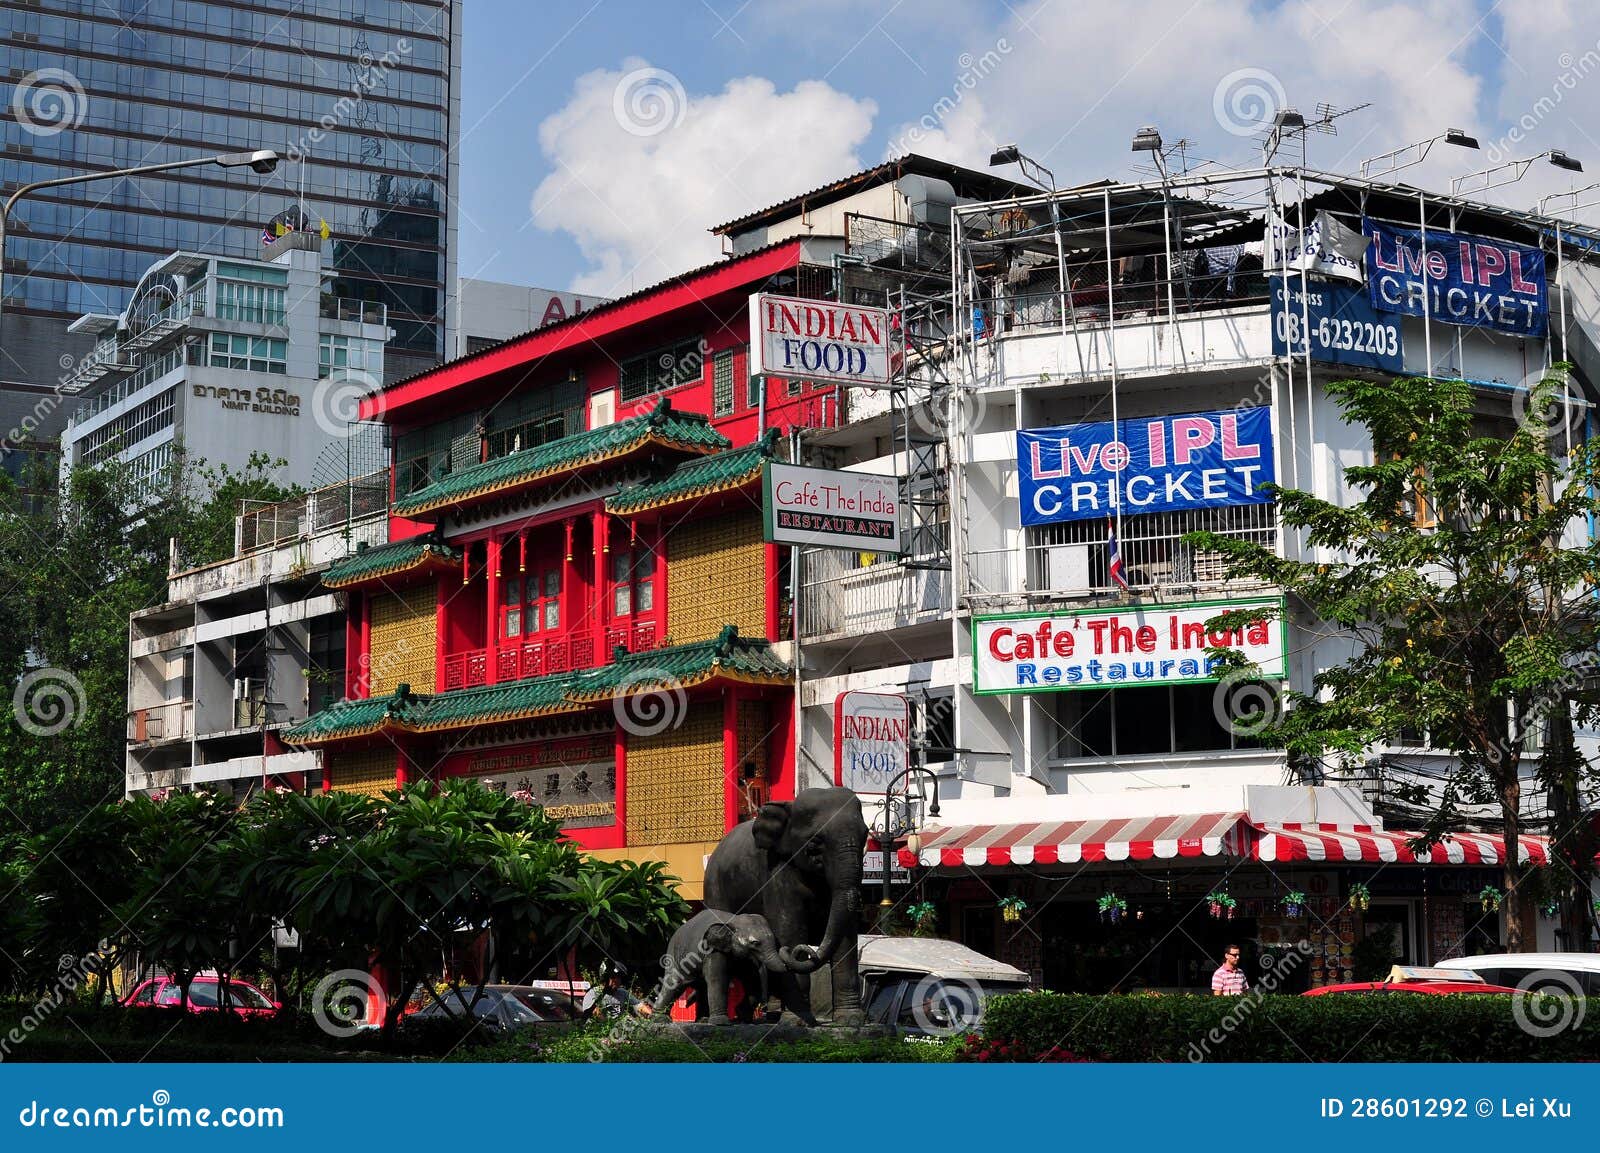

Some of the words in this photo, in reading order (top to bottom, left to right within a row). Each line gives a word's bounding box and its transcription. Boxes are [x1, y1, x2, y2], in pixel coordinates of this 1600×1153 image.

[1373, 231, 1448, 280] Live
[1459, 240, 1537, 295] IPL
[1380, 275, 1538, 328] CRICKET
[766, 302, 881, 345] INDIAN
[1276, 311, 1399, 357] 081-6232203
[783, 338, 867, 376] FOOD
[221, 400, 249, 411] NIMIT
[252, 404, 300, 416] BUILDING
[1030, 438, 1130, 480] Live
[1148, 413, 1261, 467] IPL
[776, 481, 818, 507] Café
[820, 485, 855, 510] The
[859, 490, 895, 514] India
[1033, 465, 1261, 516] CRICKET
[780, 511, 892, 537] RESTAURANT
[1087, 616, 1158, 655] The
[844, 715, 905, 742] INDIAN
[851, 752, 896, 772] FOOD
